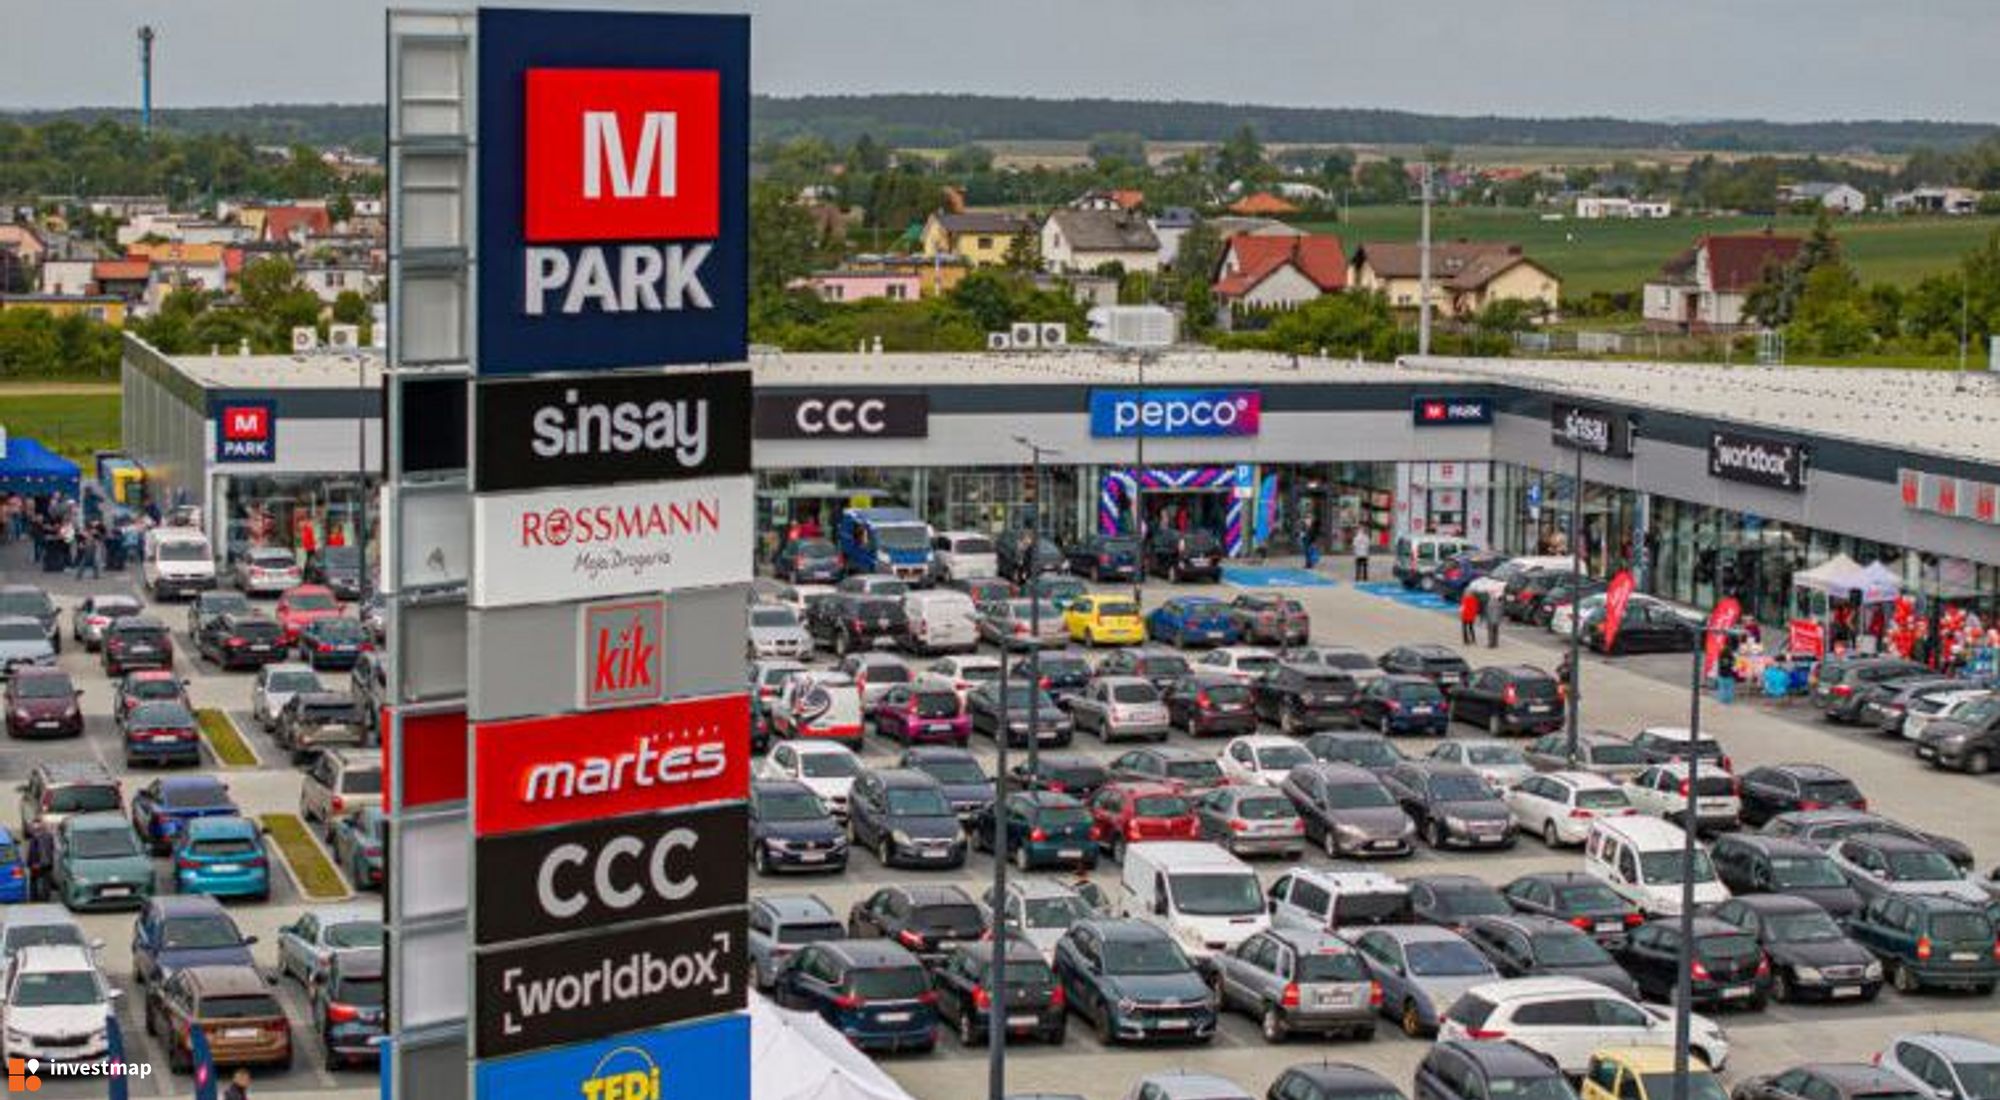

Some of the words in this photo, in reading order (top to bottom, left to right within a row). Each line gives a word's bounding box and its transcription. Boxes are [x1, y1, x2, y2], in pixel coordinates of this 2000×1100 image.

[583, 111, 677, 199] M
[525, 244, 714, 315] PARK
[234, 414, 258, 433] M
[532, 389, 708, 467] sinsay
[795, 400, 886, 432] CCC
[1447, 404, 1483, 418] PARK
[1566, 409, 1608, 452] sinsay
[224, 441, 267, 456] PARK
[1720, 444, 1786, 475] worldbox
[522, 498, 720, 547] ROSSMANN
[573, 552, 609, 579] Moja
[610, 549, 672, 576] Drogeria
[594, 616, 654, 694] kik
[525, 736, 727, 802] martes
[537, 828, 699, 918] CCC
[516, 950, 719, 1018] worldbox
